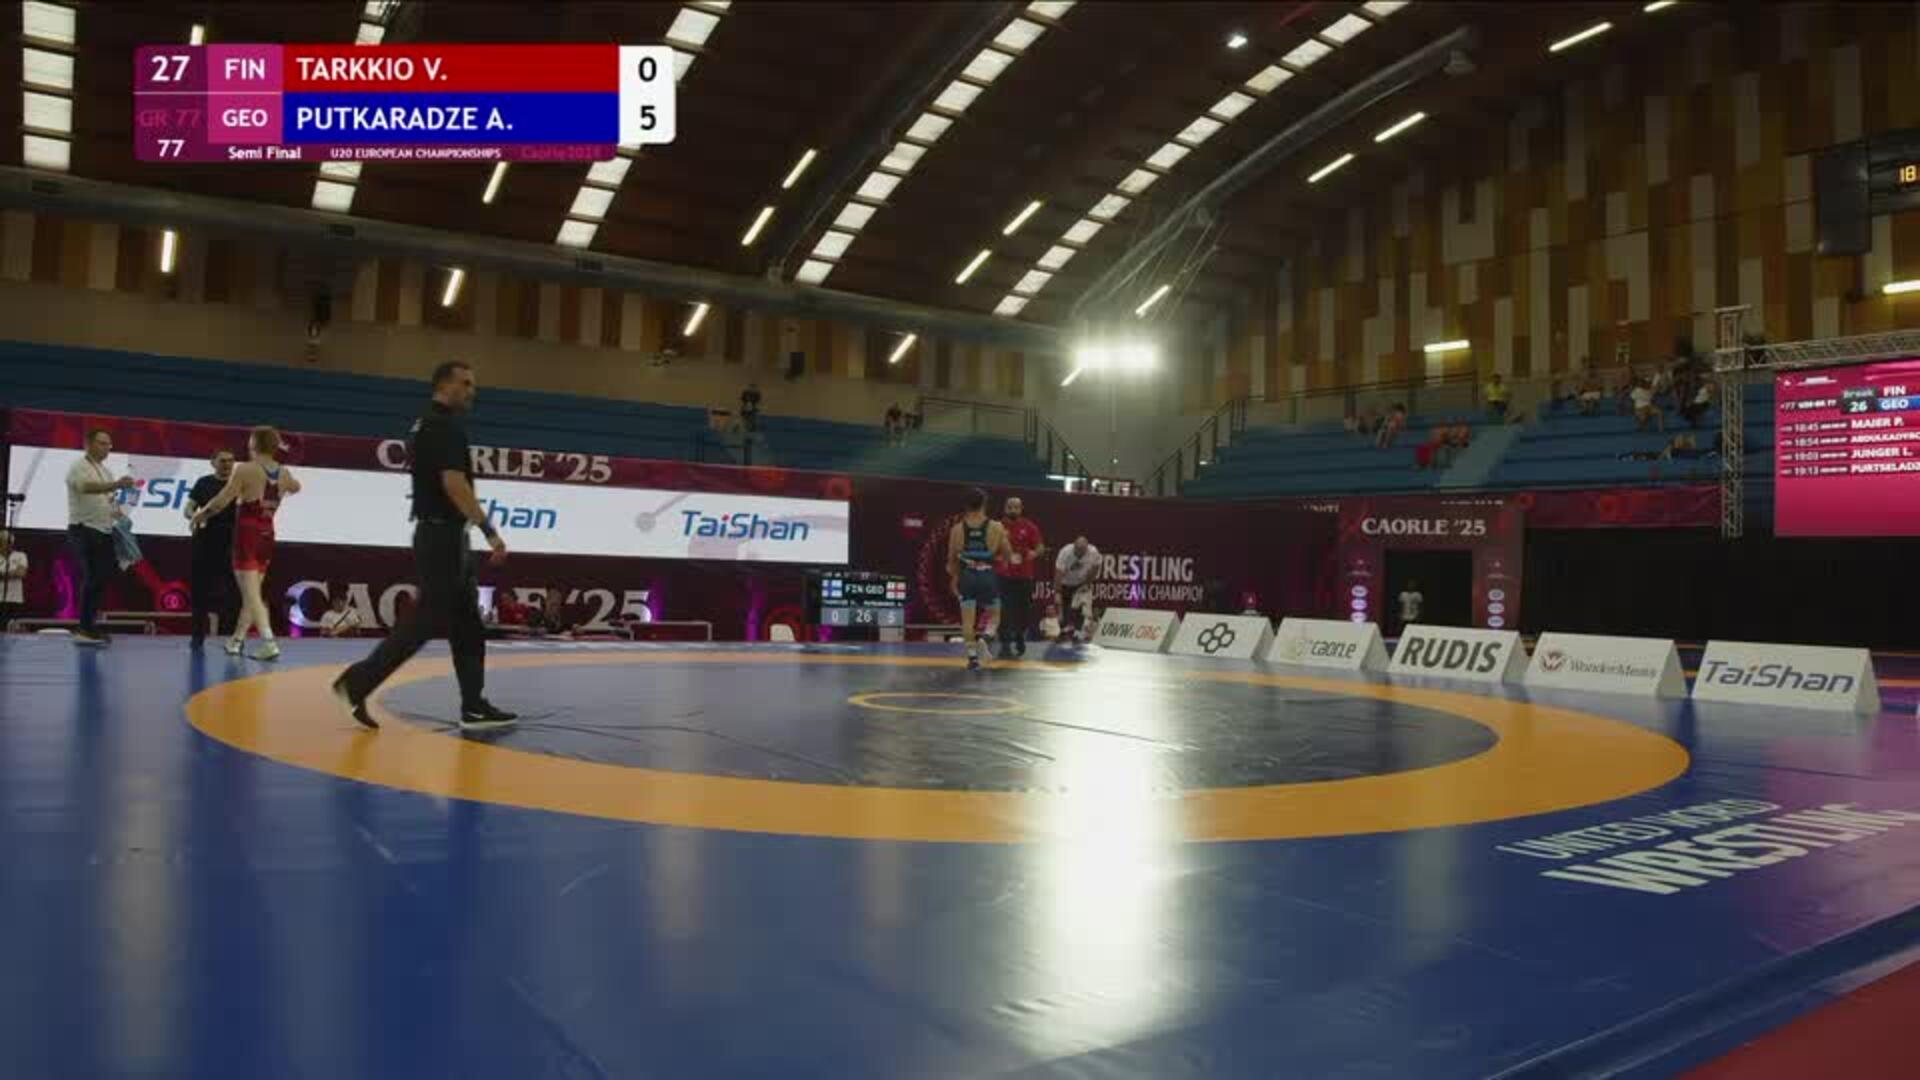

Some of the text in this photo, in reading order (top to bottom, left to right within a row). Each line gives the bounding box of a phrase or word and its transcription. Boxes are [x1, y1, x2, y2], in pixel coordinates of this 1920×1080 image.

[1883, 385, 1906, 397] FIN
[1849, 401, 1868, 413] 26
[1881, 398, 1909, 410] GEO
[1851, 417, 1891, 429] MAIER
[376, 439, 545, 478] CRLE
[682, 510, 810, 541] TaiShan
[1361, 517, 1449, 536] CAORLE
[1096, 554, 1194, 582] RESTLING
[845, 583, 863, 594] FIN
[865, 585, 884, 595] GEO
[1090, 583, 1146, 600] UROPEAN
[285, 580, 548, 629] CAOLE
[855, 609, 872, 623] 26
[1400, 636, 1502, 673] RUDIS
[1704, 660, 1855, 693] TaiShan
[1495, 799, 1782, 860] UNITED WORLD
[1540, 803, 1920, 895] WRESTLING
